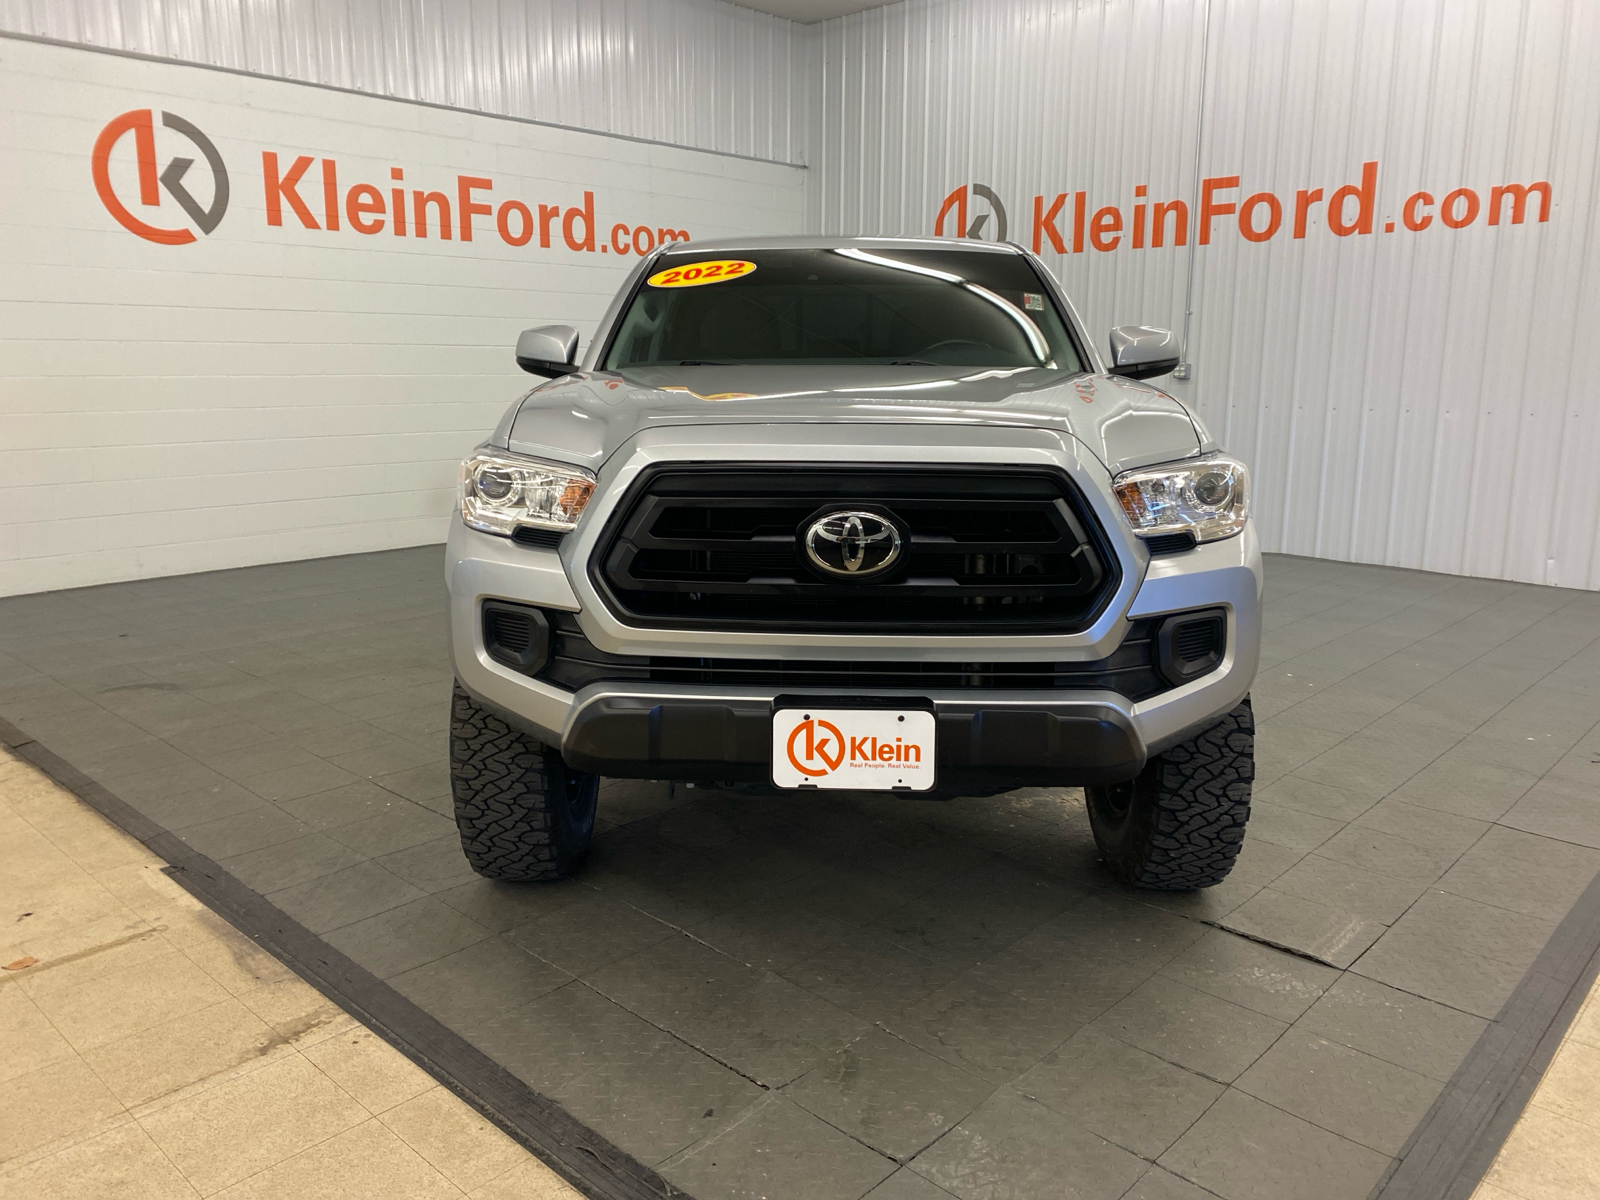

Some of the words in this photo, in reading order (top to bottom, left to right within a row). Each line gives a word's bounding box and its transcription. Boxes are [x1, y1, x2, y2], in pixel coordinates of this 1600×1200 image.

[261, 150, 690, 258] KleinFord.com
[1031, 160, 1553, 256] KleinFord.com
[660, 262, 745, 285] 2022
[850, 736, 921, 763] Klein
